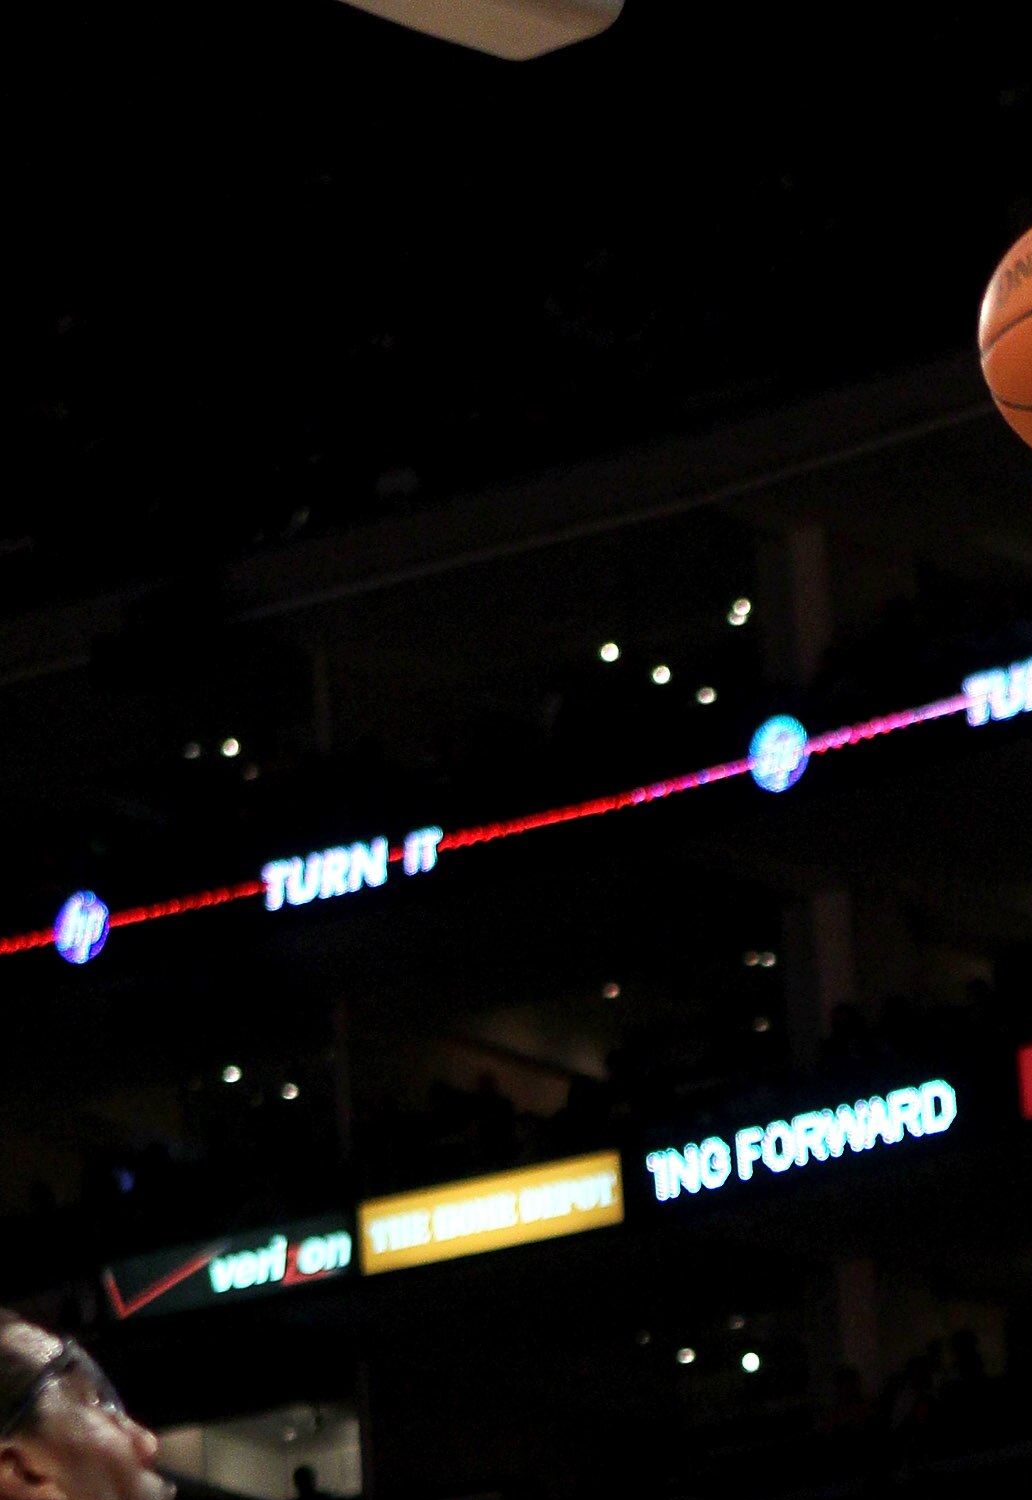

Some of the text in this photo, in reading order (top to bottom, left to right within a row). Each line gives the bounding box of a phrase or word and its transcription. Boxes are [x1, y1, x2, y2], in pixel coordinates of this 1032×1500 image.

[261, 826, 443, 911] TURN IT
[735, 1079, 957, 1181] FORWARD
[207, 1230, 352, 1294] verizon
